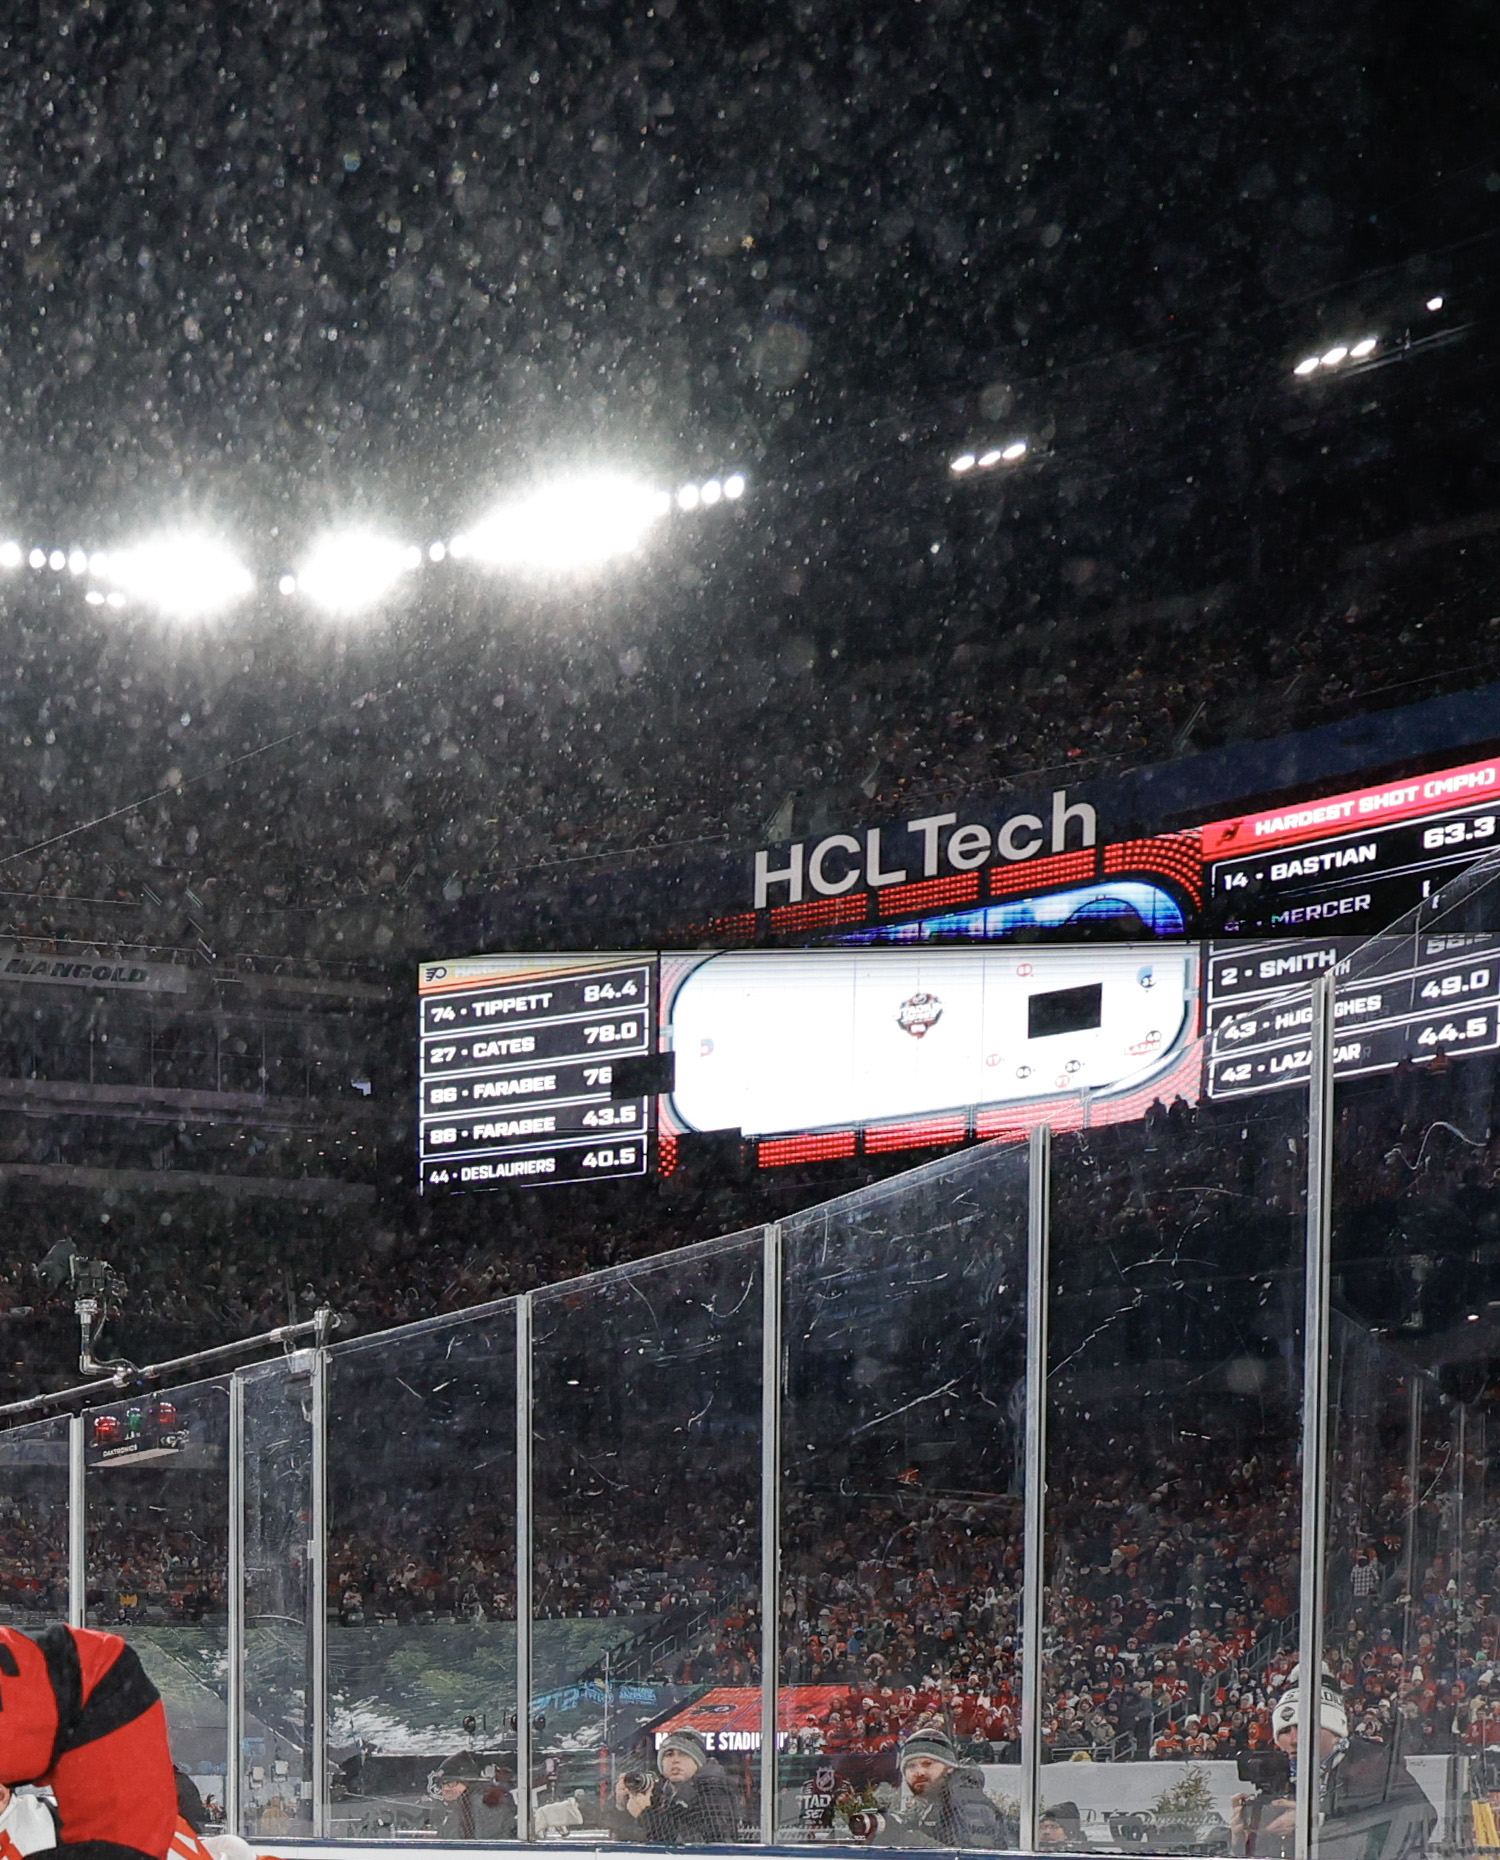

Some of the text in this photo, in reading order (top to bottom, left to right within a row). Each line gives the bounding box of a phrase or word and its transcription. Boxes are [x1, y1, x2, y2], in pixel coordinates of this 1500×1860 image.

[1255, 767, 1497, 837] HARDEST SHOT (MPH)
[753, 790, 1098, 910] HCLTech
[1223, 815, 1497, 891] 14 BASTIAN 63.3
[1270, 893, 1373, 928] MERCER
[4, 958, 148, 983] MANGOLD
[1220, 948, 1337, 986] 2 SMITH
[1420, 968, 1490, 999] 49.0
[430, 979, 638, 1023] 74 TIPPETT 84.4
[430, 1021, 638, 1064] 27 CATES 78.0
[1220, 1064, 1253, 1084] 42
[1417, 1018, 1489, 1046] 44.5
[430, 1087, 458, 1105] 86
[472, 1075, 557, 1100] FARABEE
[429, 1105, 637, 1145] 86 FARABEE 43.5
[429, 1147, 636, 1184] 44 DESLAURIERS 40.5
